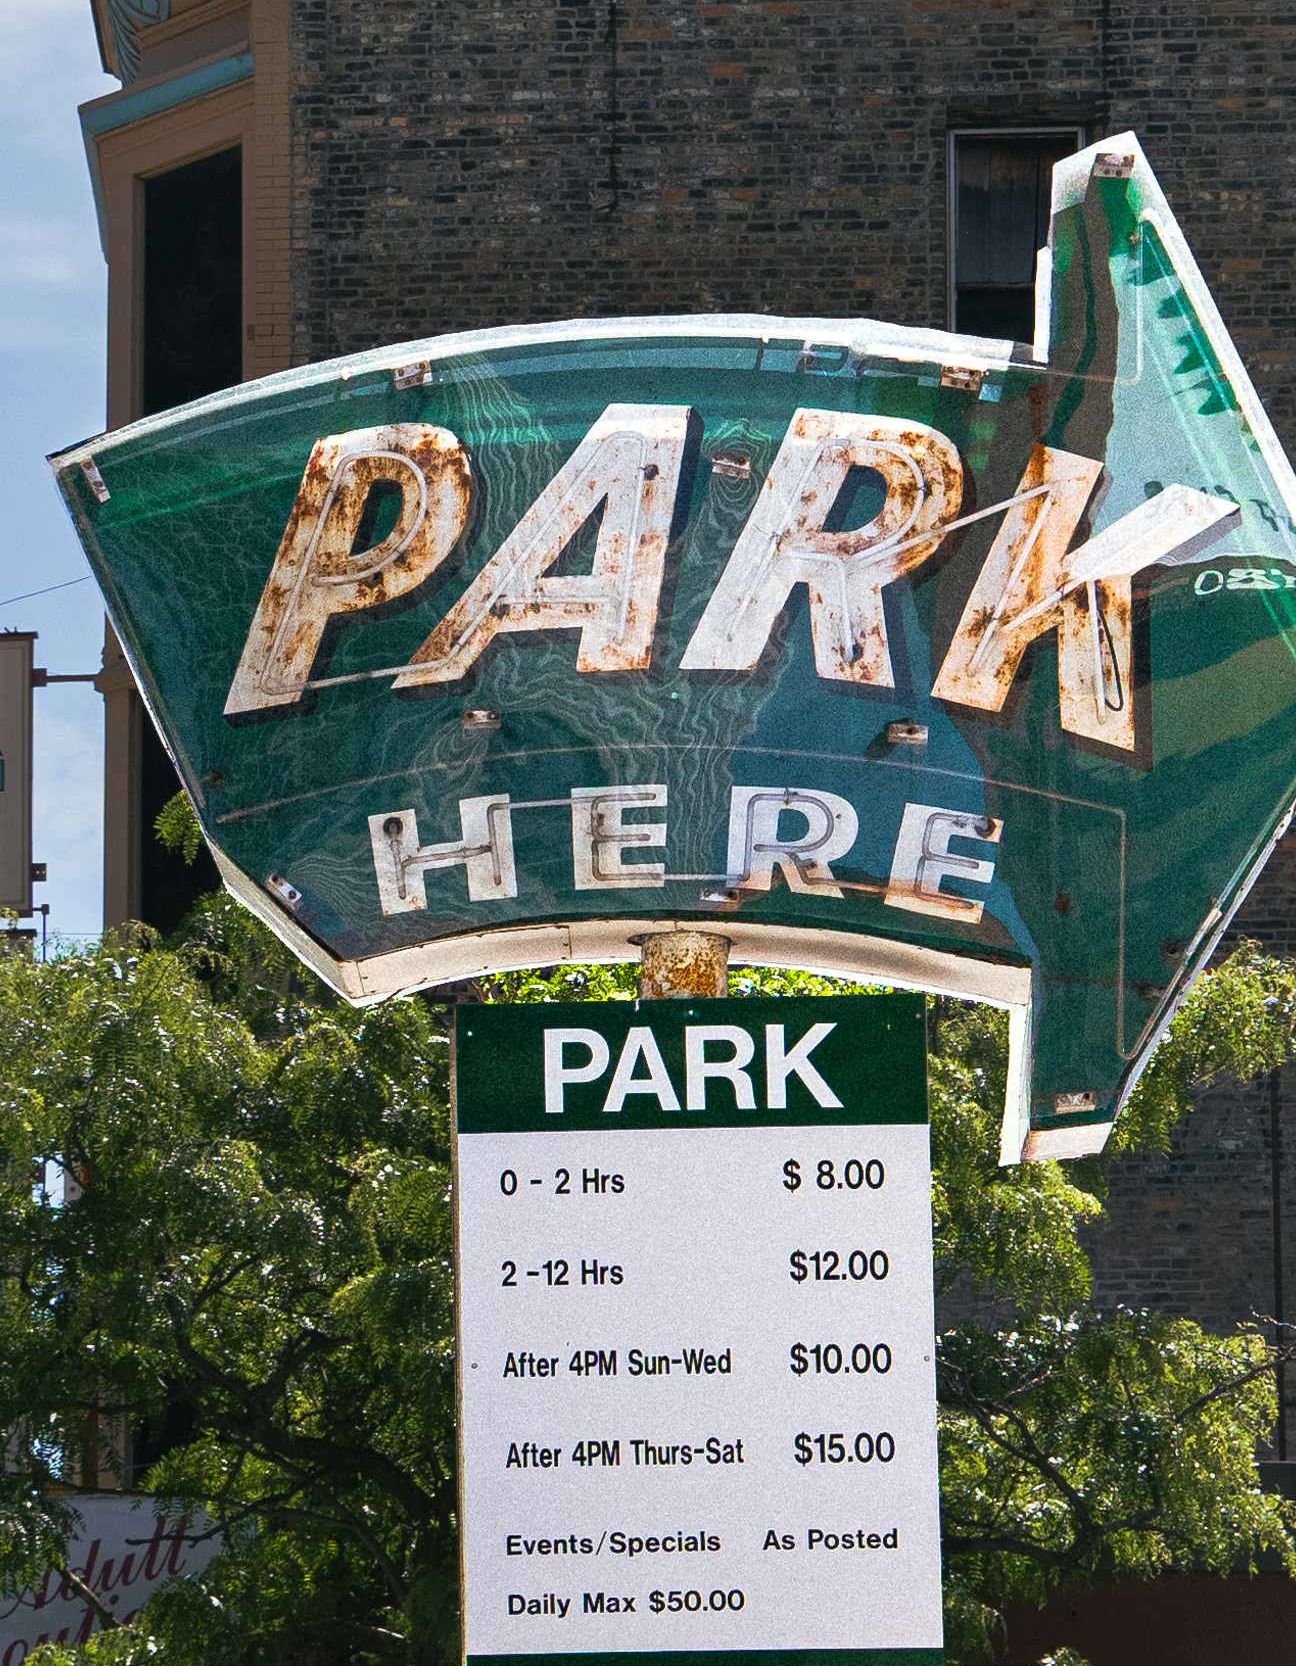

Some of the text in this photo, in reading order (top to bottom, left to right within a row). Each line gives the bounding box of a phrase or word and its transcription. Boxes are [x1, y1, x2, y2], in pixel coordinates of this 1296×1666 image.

[221, 401, 1241, 757] PARK
[368, 783, 1004, 925] HERE
[543, 1021, 845, 1114] PARK
[499, 1169, 518, 1196] 0
[554, 1168, 571, 1195] 2
[582, 1167, 626, 1194] Hrs
[816, 1158, 886, 1191] 8.00
[501, 1260, 517, 1287] 2
[581, 1258, 624, 1286] Hrs
[789, 1249, 890, 1284] $12.00
[503, 1341, 892, 1378] After 4PM Sun-Wed $10.00
[505, 1431, 896, 1469] After 4PM Thurs-Sat $15.00
[505, 1527, 899, 1558] Events/Specials As Posted
[507, 1589, 746, 1620] Daily Max $50.00
